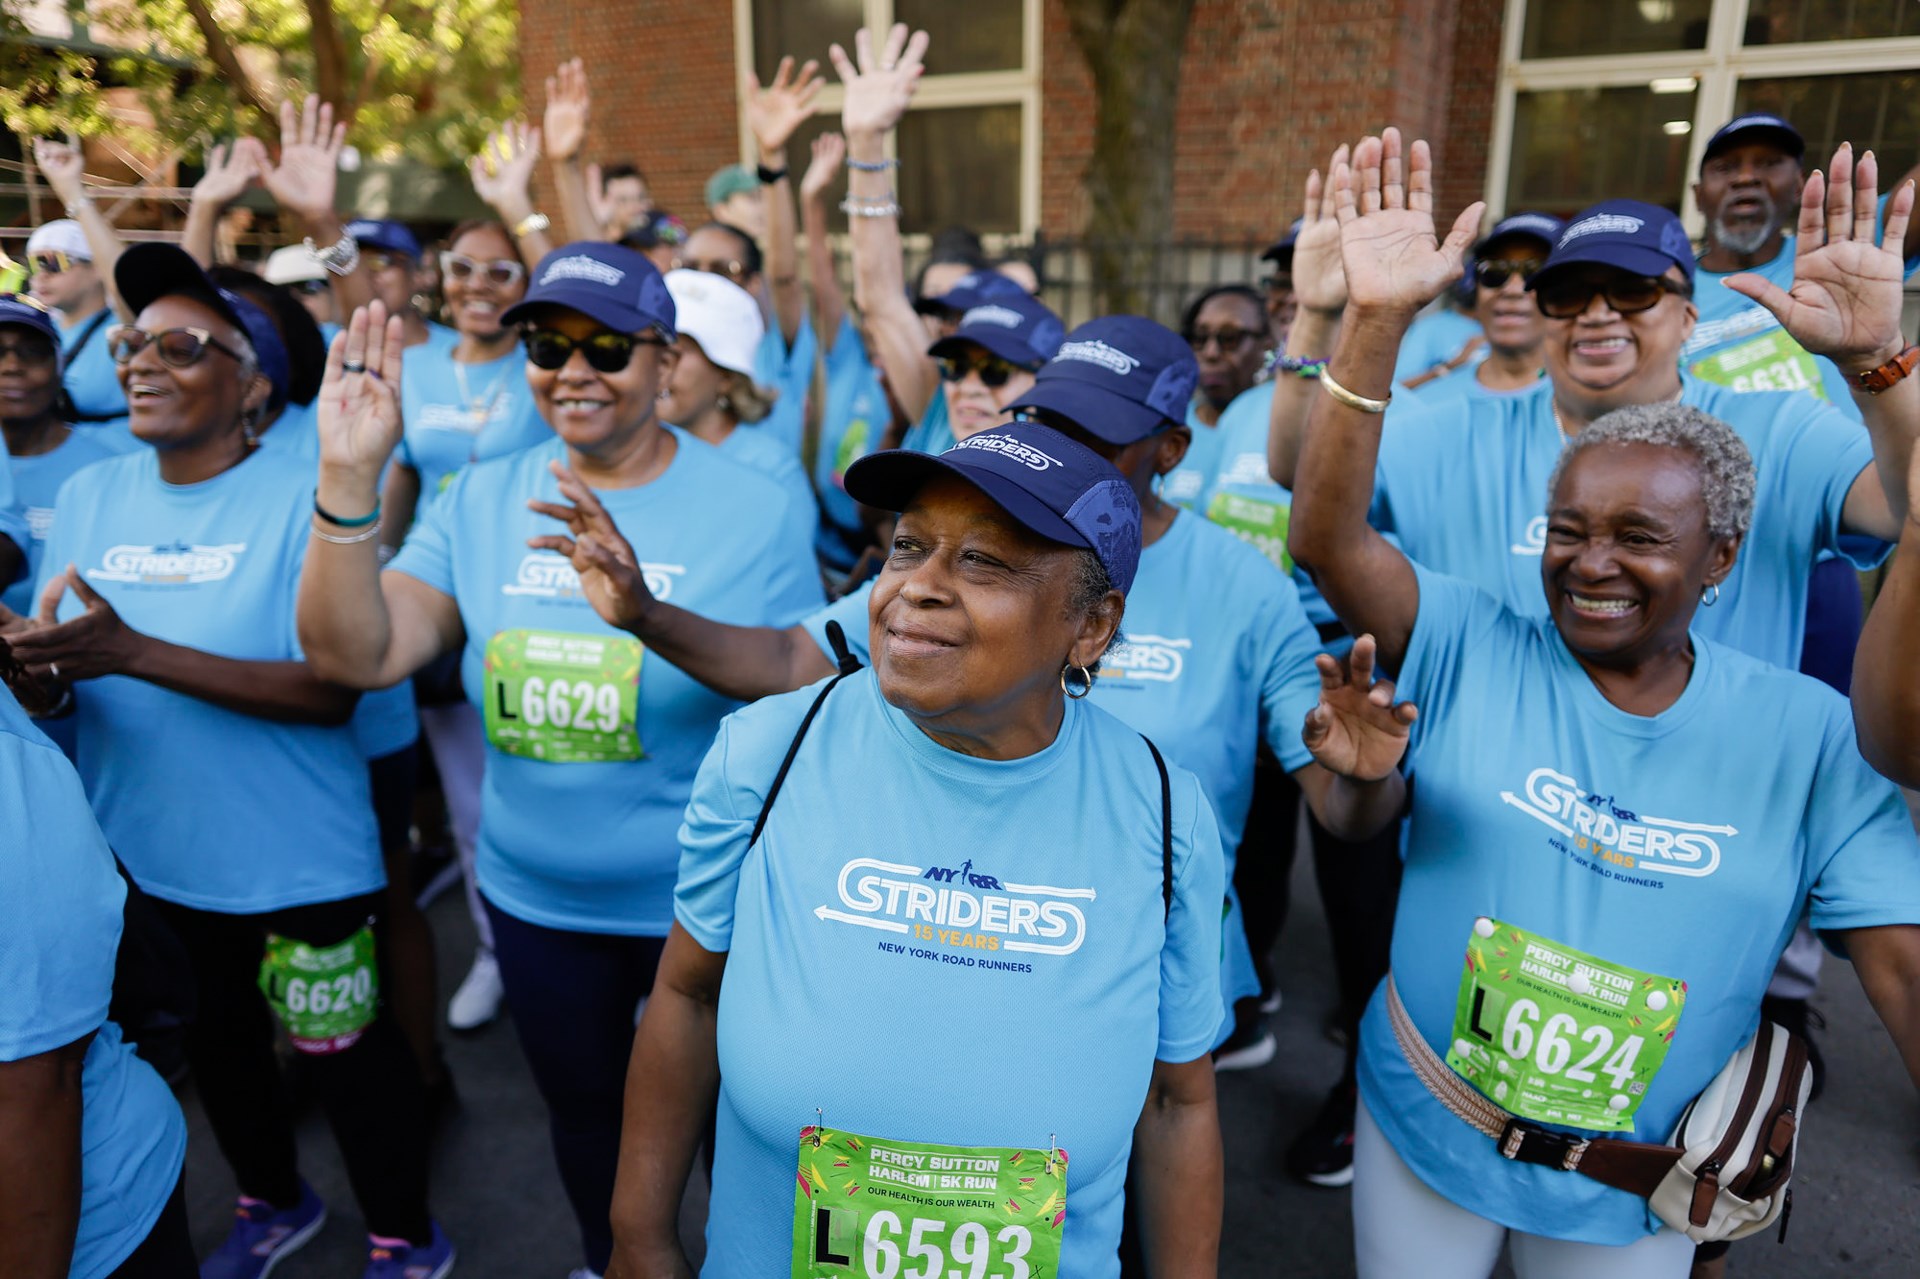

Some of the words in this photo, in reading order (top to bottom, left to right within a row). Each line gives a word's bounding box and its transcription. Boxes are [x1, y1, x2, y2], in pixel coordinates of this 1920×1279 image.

[497, 683, 517, 720] L
[521, 676, 620, 733] 6629
[1614, 872, 1664, 889] RUNNERS
[847, 868, 1077, 945] STRIDERS
[914, 923, 933, 941] 15
[938, 928, 999, 951] YEARS
[878, 941, 905, 955] NEW
[909, 947, 939, 962] YORK
[942, 954, 975, 967] ROAD
[978, 959, 1032, 974] RUNNERS
[1525, 943, 1573, 968] PERCY
[1573, 961, 1635, 992] SUTTON
[286, 965, 372, 1015] 6620
[1517, 977, 1532, 988] OUR
[1533, 984, 1563, 1000] HEALTH
[1572, 999, 1590, 1011] OUR
[1590, 1004, 1623, 1020] WEALTH
[1599, 988, 1630, 1007] RUN
[1471, 986, 1492, 1042] L
[1502, 998, 1645, 1090] 6624
[869, 1165, 930, 1188] HARLEM
[940, 1175, 962, 1189] 5K
[964, 1176, 997, 1189] RUN
[870, 1148, 925, 1169] PERCY
[929, 1156, 1000, 1172] SUTTON
[867, 1186, 887, 1197] OUR
[888, 1190, 924, 1206] HEALTH
[924, 1198, 934, 1206] IS
[935, 1199, 955, 1207] OUR
[957, 1200, 995, 1209] WEALTH
[816, 1208, 849, 1265] L
[863, 1210, 1034, 1279] 6593
